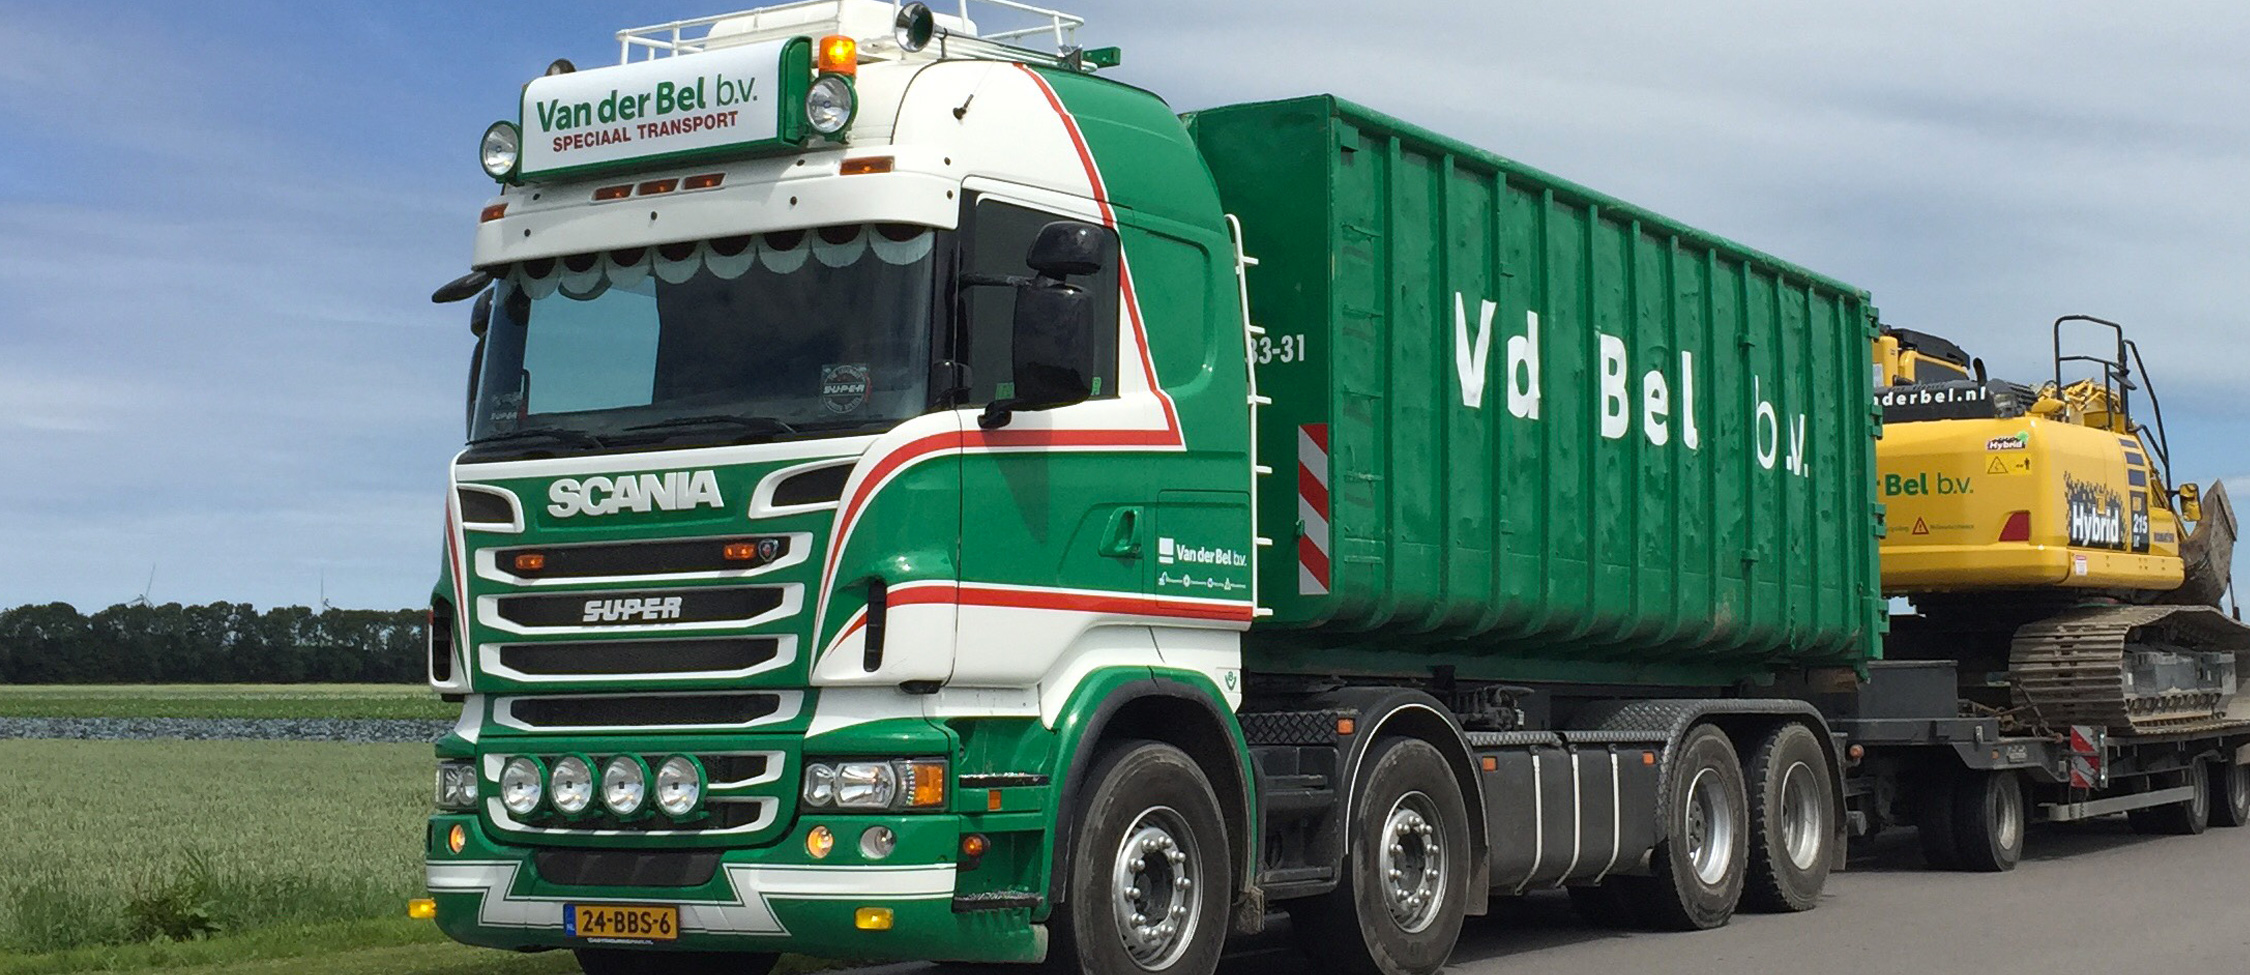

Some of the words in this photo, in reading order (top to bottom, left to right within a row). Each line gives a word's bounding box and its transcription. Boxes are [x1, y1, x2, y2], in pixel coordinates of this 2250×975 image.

[537, 98, 592, 133] Van
[597, 89, 651, 124] der
[656, 76, 706, 116] Bel
[716, 73, 758, 107] b.v.
[552, 127, 631, 152] SPECIAAL
[637, 110, 738, 140] TRANSPORT
[823, 384, 866, 394] SUPER
[1455, 291, 1540, 421] Vd
[1600, 333, 1698, 450] Bel
[1755, 374, 1809, 478] b.v.
[547, 470, 725, 518] SCANIA
[1885, 472, 1929, 496] Bel
[1937, 472, 1974, 495] b.v.
[2072, 502, 2119, 546] Hybrid
[2133, 513, 2148, 534] 215
[1176, 544, 1197, 562] Van
[1197, 546, 1215, 564] der
[1215, 548, 1232, 566] Bel
[582, 596, 683, 622] SUPER
[582, 910, 671, 935] 24-BBS-6
